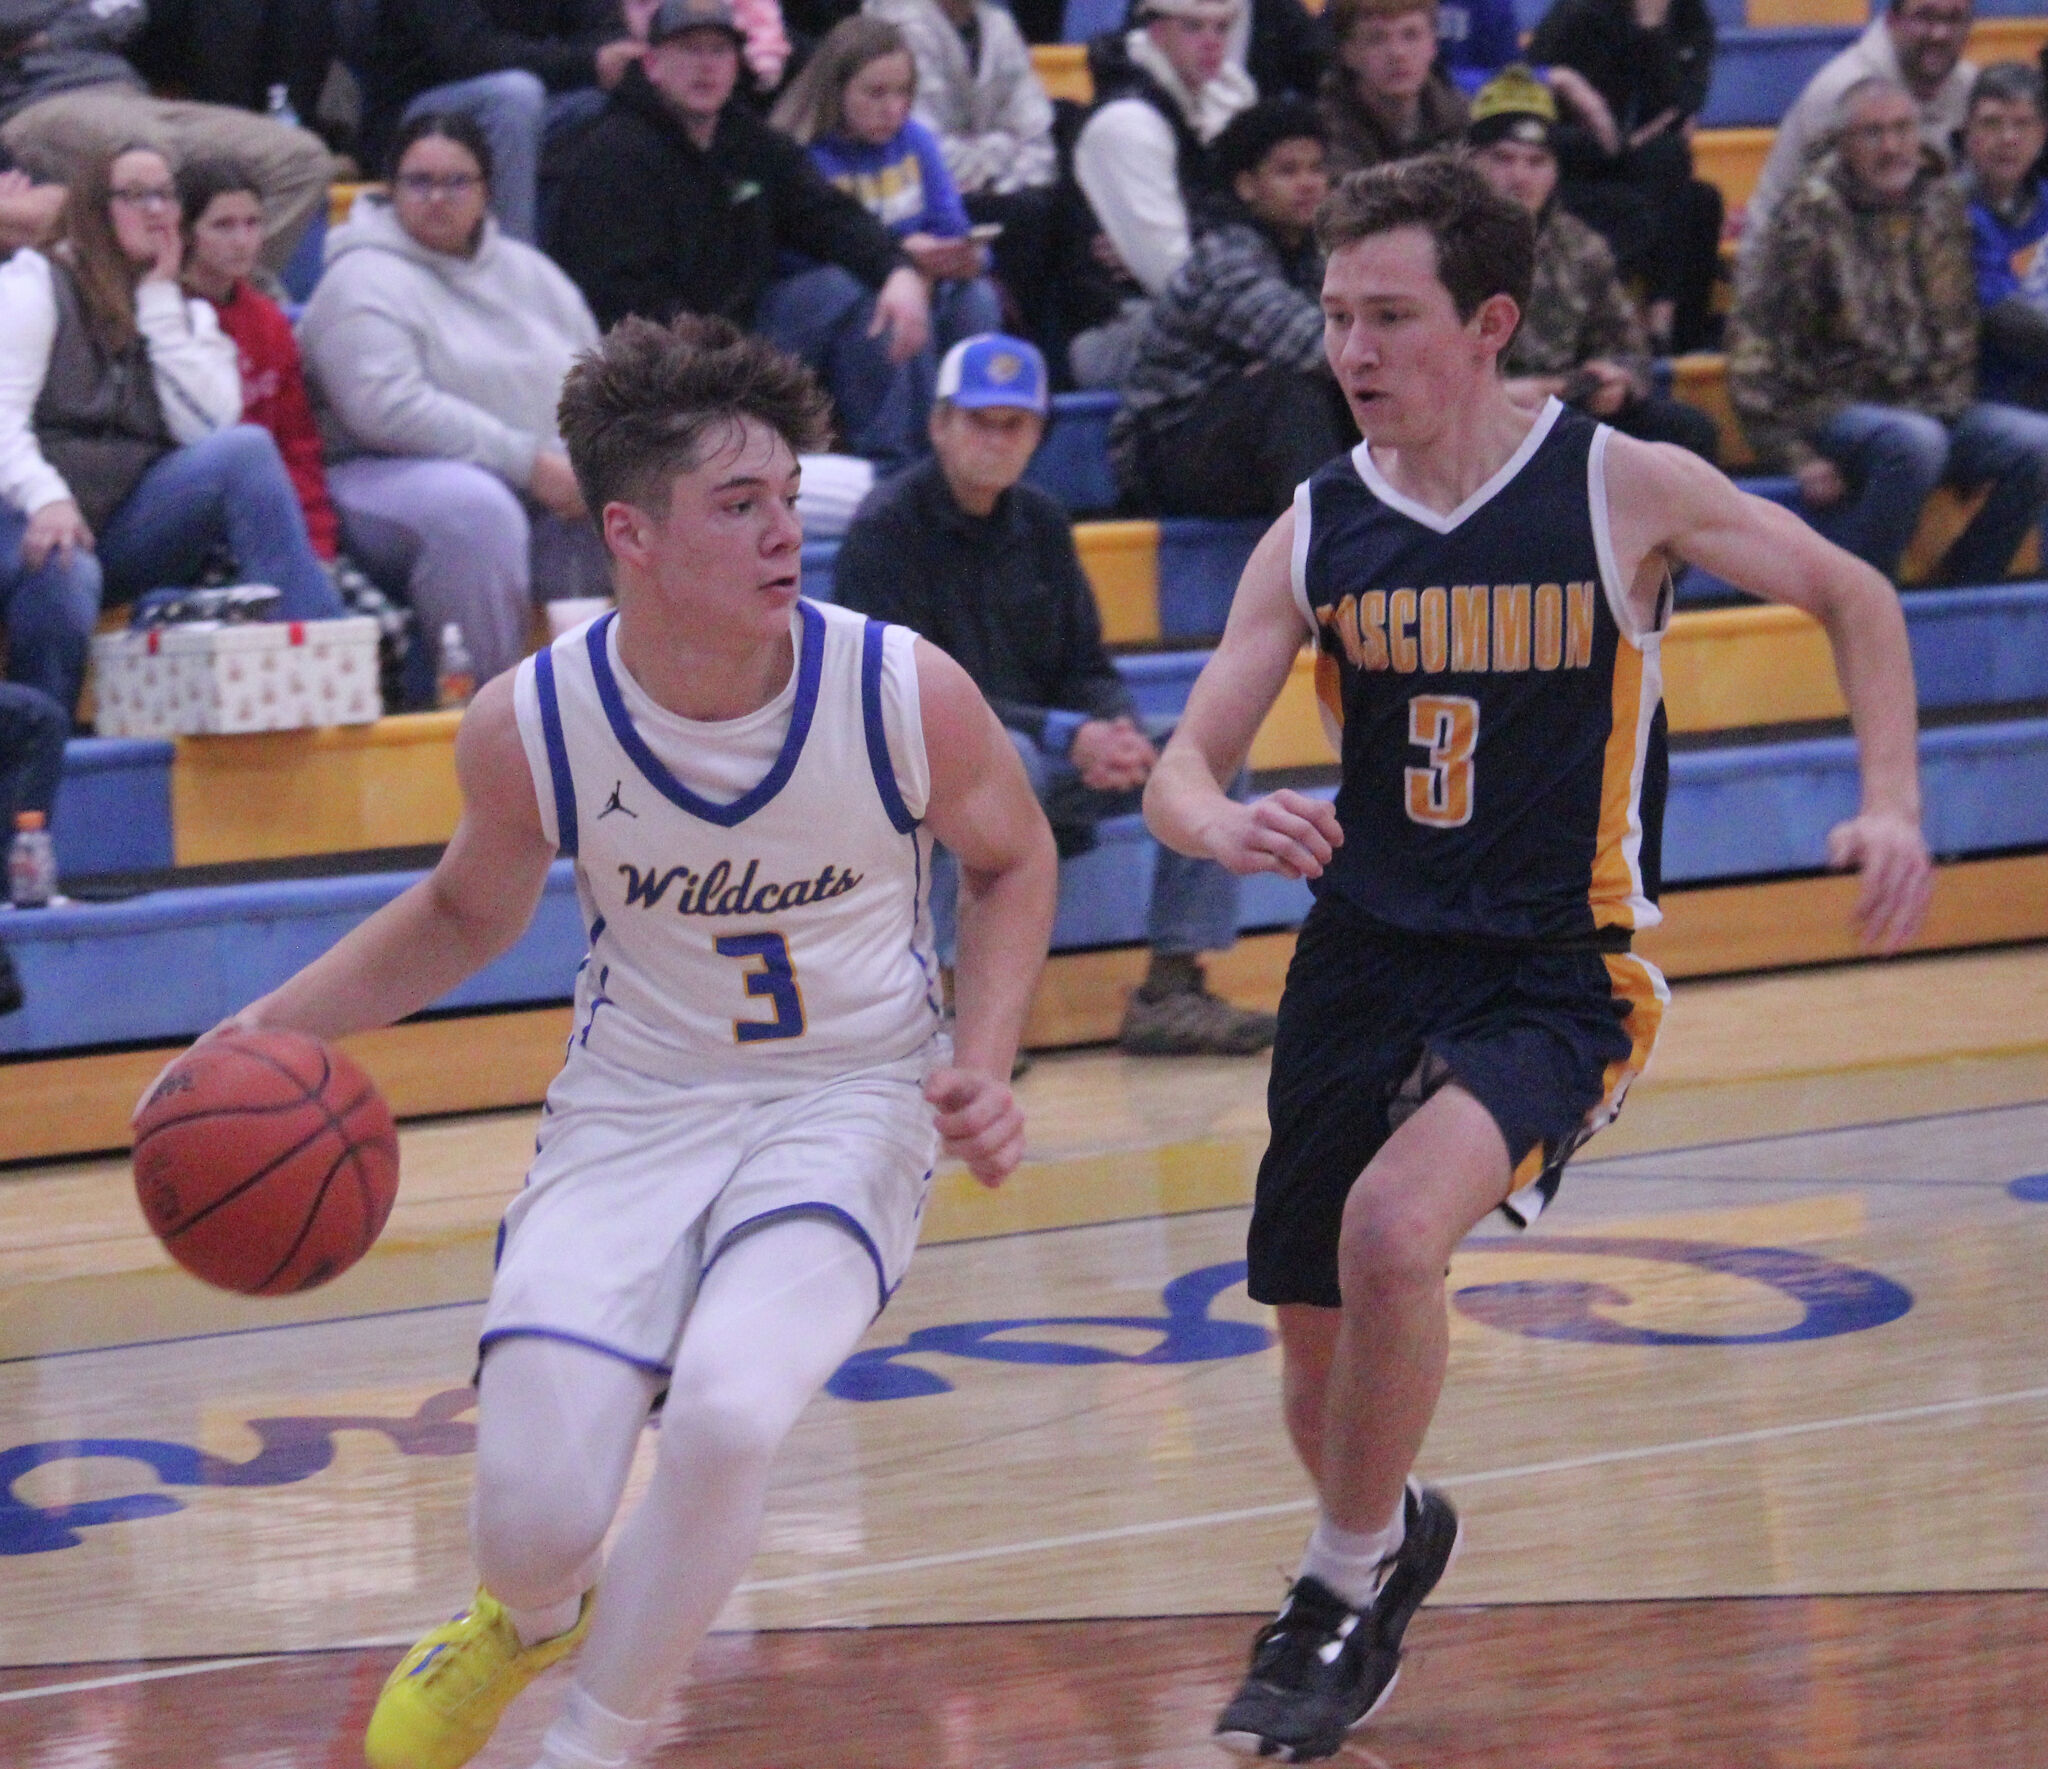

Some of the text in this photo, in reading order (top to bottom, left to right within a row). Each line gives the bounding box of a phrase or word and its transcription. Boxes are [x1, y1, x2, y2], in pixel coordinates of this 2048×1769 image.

[1315, 581, 1594, 673] OSCOMMON
[1404, 695, 1480, 829] 3
[618, 858, 864, 916] Wildcats
[712, 932, 806, 1044] 3
